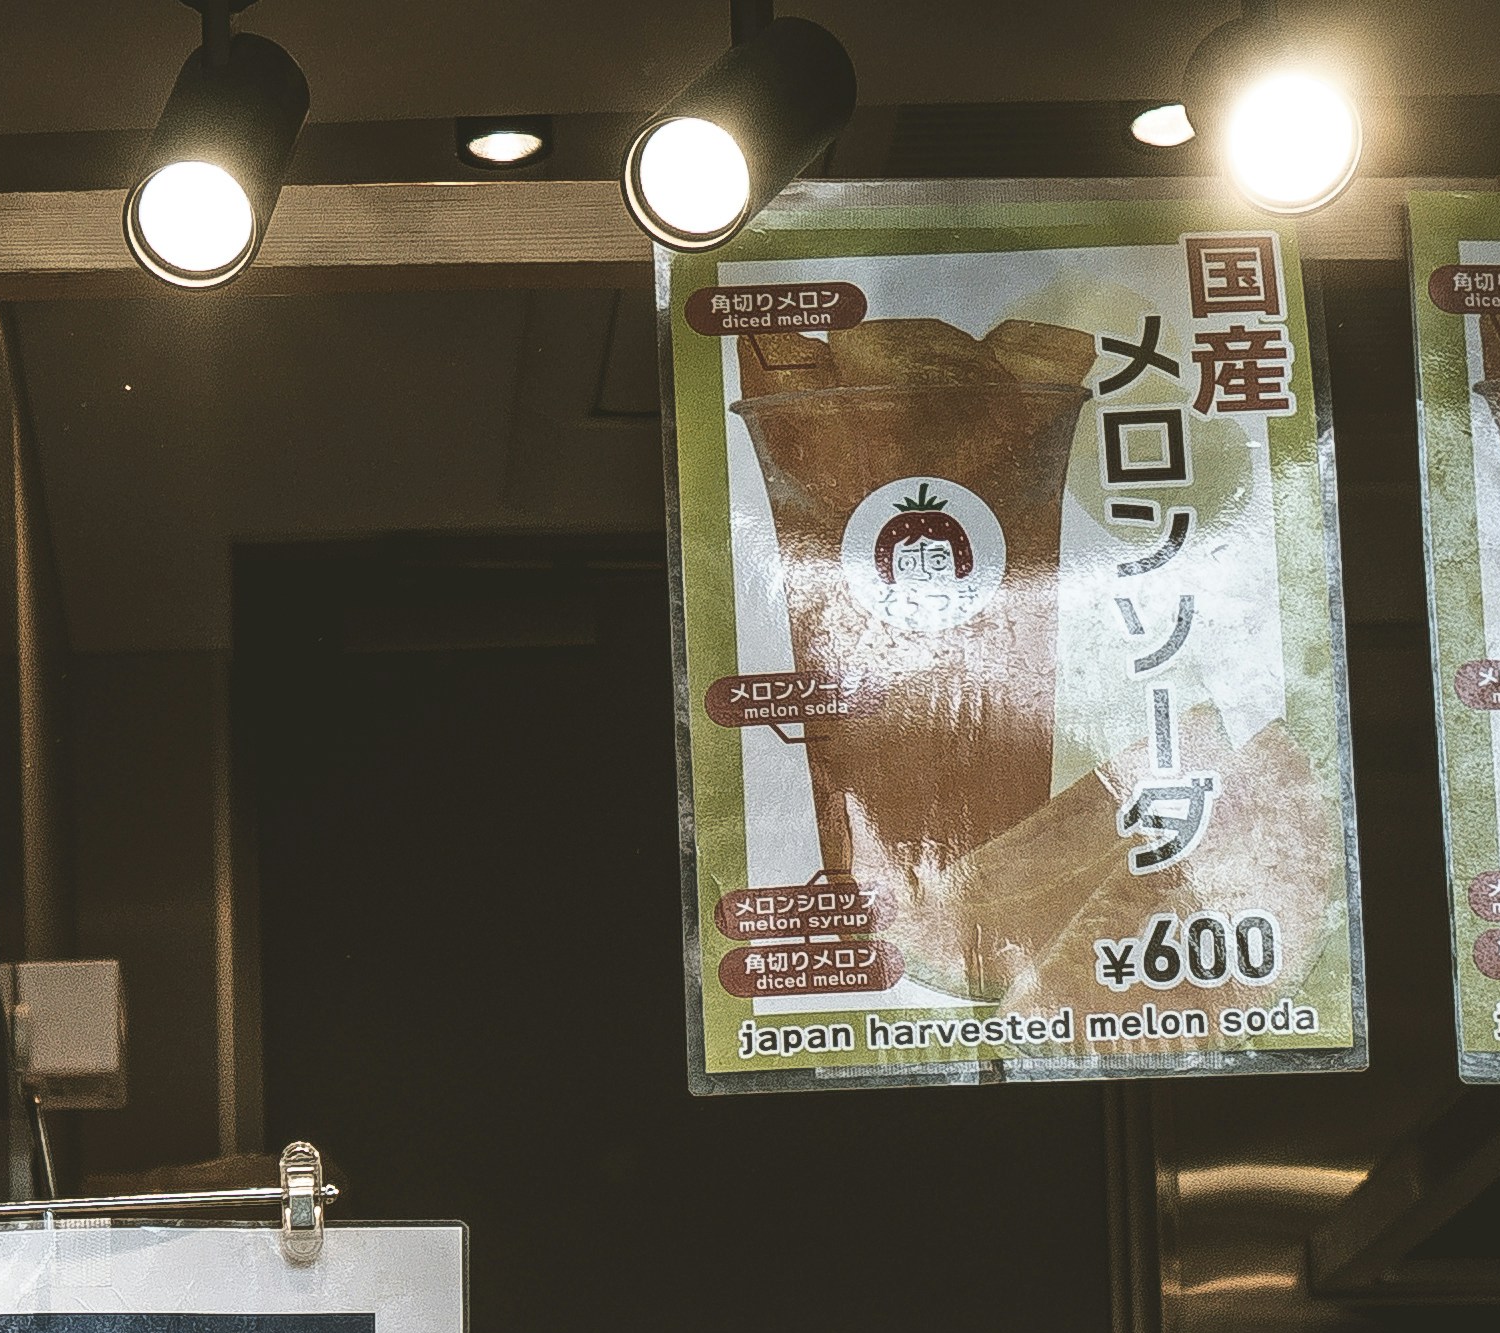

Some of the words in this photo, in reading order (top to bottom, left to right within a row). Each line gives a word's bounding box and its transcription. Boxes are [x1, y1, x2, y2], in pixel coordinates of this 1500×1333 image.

[711, 291, 840, 313] 角切りメロン
[722, 313, 771, 328] diced
[778, 312, 831, 326] melon
[1187, 234, 1292, 415] 国産
[1099, 314, 1215, 873] メロンソーダ
[744, 703, 799, 719] melon
[805, 701, 849, 715] soda
[739, 916, 801, 932] melon
[808, 913, 868, 928] syrup
[744, 949, 877, 974] 角切りメロン
[1101, 916, 1279, 984] ¥600
[756, 972, 806, 989] diced
[813, 971, 868, 987] melon
[740, 1017, 852, 1056] japan
[866, 1011, 1071, 1048] harvested
[1089, 1006, 1207, 1040] melon
[1221, 1001, 1316, 1035] soda
